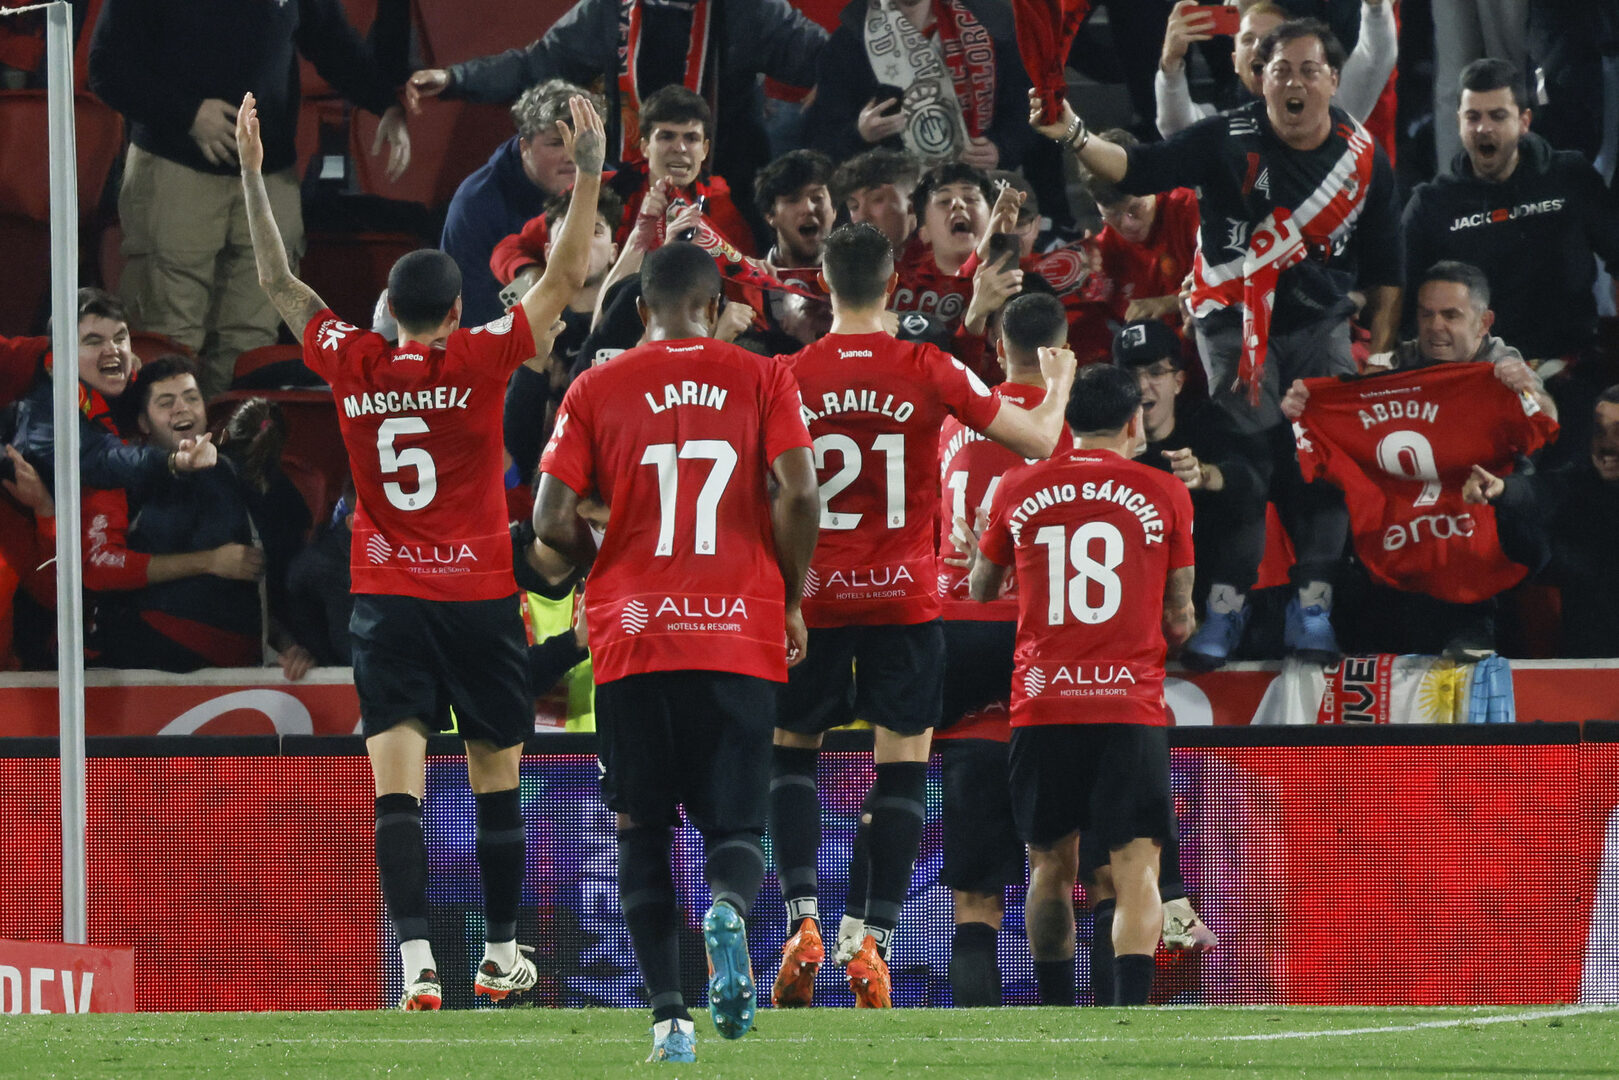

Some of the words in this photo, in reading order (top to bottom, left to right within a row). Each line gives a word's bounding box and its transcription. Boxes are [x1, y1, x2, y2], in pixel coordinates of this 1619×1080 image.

[838, 348, 873, 360] juaneda
[644, 380, 728, 414] LARIN
[1358, 400, 1439, 430] ABDON
[376, 416, 437, 512] 5
[1376, 430, 1442, 507] 9
[813, 433, 906, 529] 21
[639, 439, 739, 557] 17
[1008, 483, 1077, 547] ANTONIO
[1081, 479, 1165, 545] SÁNCHEZ
[397, 543, 478, 563] ALUA
[826, 565, 914, 588] ALUA
[1033, 521, 1125, 626] 18
[655, 596, 748, 620] ALUA
[667, 622, 698, 631] HOTELS
[700, 623, 705, 631] &
[707, 622, 741, 632] RESORTS
[1051, 665, 1136, 685] ALUA
[1060, 688, 1088, 697] HOTELS
[1095, 688, 1127, 696] RESORTS
